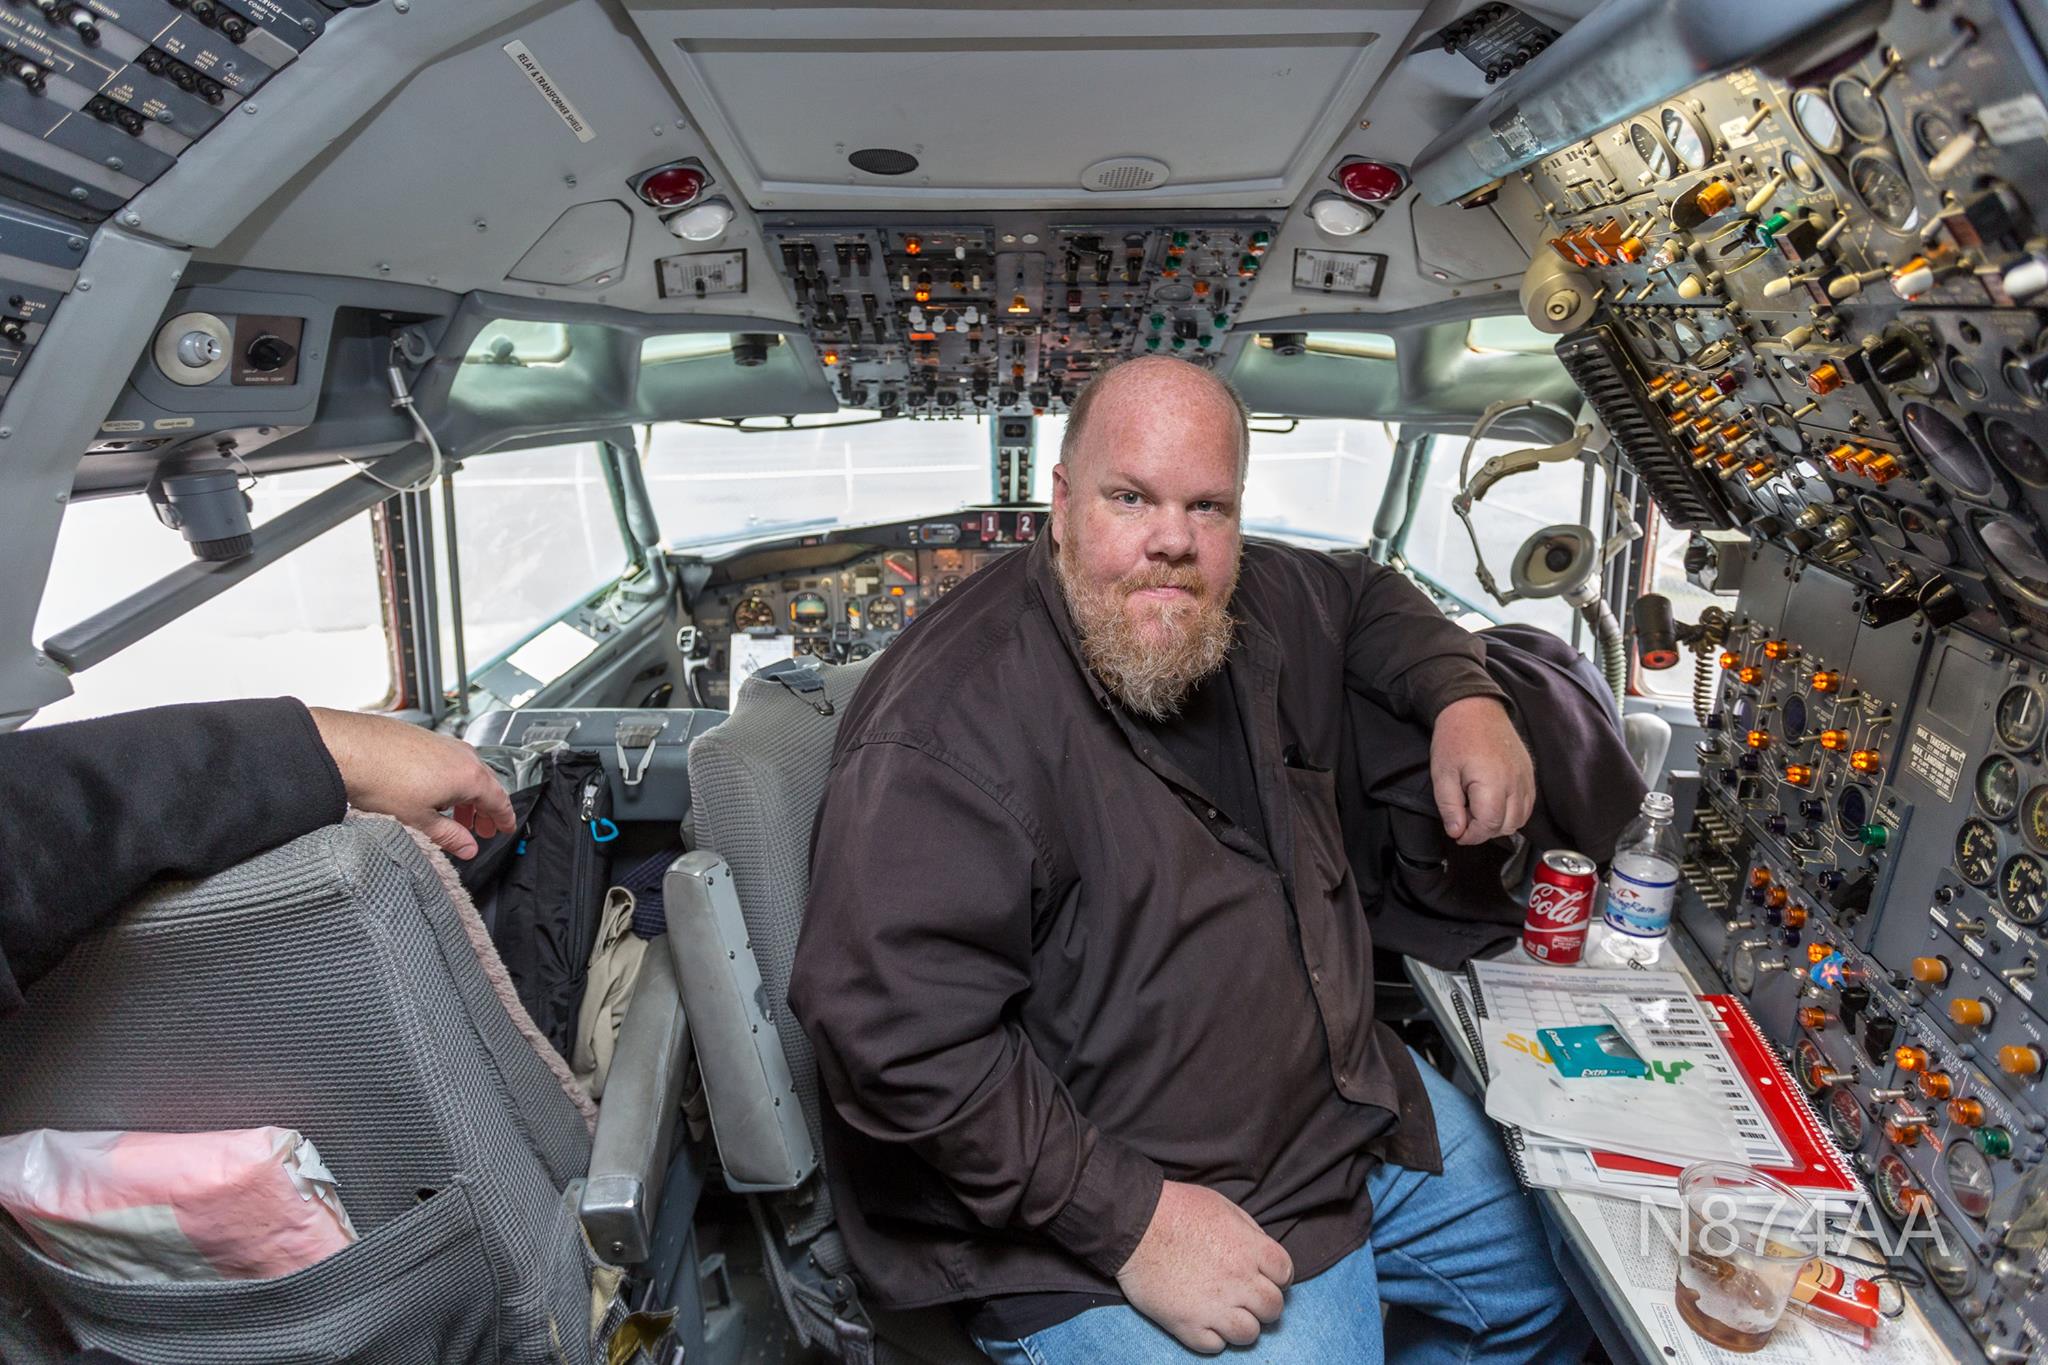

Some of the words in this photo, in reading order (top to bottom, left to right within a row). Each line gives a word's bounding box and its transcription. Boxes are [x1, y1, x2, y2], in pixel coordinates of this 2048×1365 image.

[517, 53, 536, 71] RELAY
[535, 76, 570, 117] TRANSFORMER
[565, 114, 583, 132] SHIELD
[986, 516, 994, 532] 1
[1021, 516, 1031, 532] 2
[1930, 735, 1951, 754] TAKEOFF
[1924, 752, 1945, 772] LANDING
[1988, 905, 2007, 922] ENGINE
[2007, 920, 2035, 946] VIBRATION
[1986, 986, 2002, 1004] FILTER
[1915, 1018, 1942, 1047] HYDRAULIC
[1942, 1045, 1963, 1068] SYSTEM
[1581, 1068, 1608, 1078] Extra
[1995, 1109, 2020, 1137] SYSTEM
